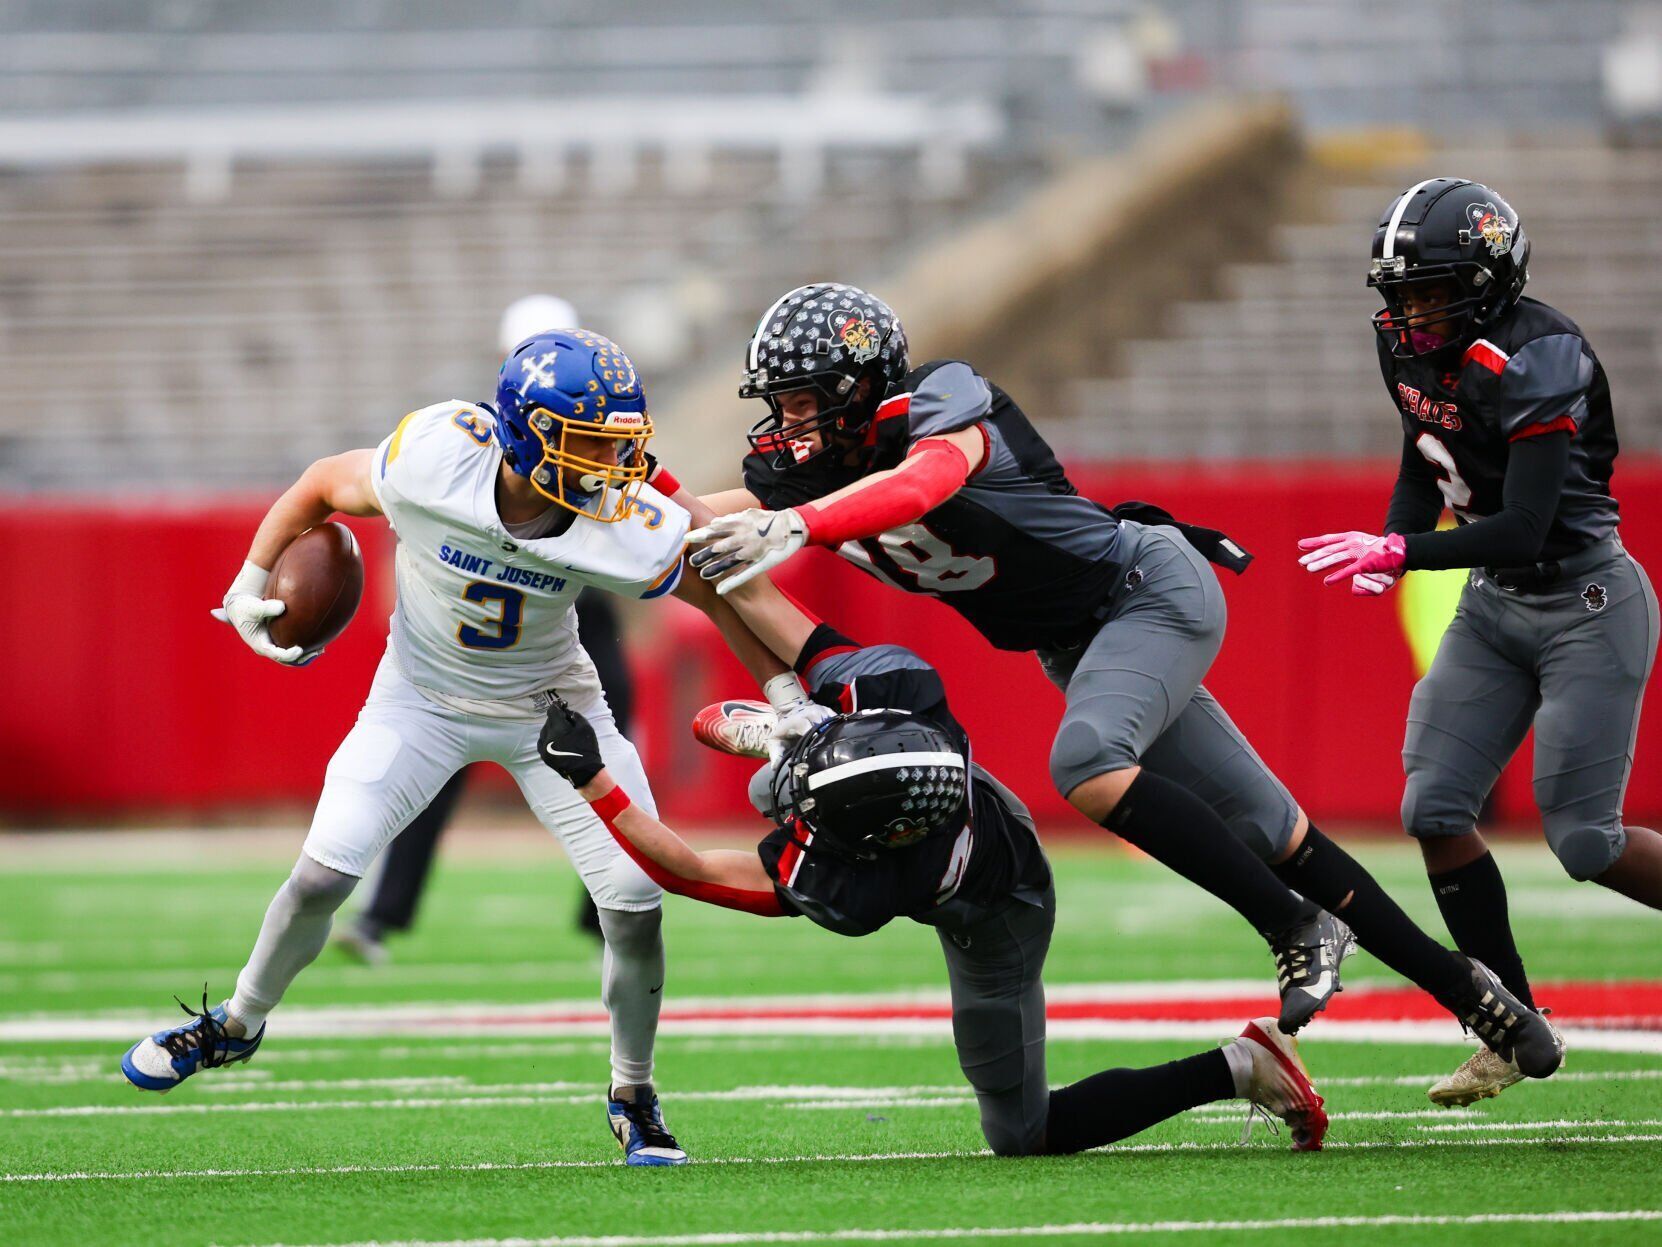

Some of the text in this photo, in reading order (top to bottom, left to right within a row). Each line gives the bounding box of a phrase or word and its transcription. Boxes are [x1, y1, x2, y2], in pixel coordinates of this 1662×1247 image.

[451, 408, 493, 448] 3
[1415, 431, 1486, 525] 2
[615, 493, 666, 531] 3
[438, 545, 493, 576] SAINT
[496, 565, 568, 592] JOSEPH
[455, 579, 527, 651] 3
